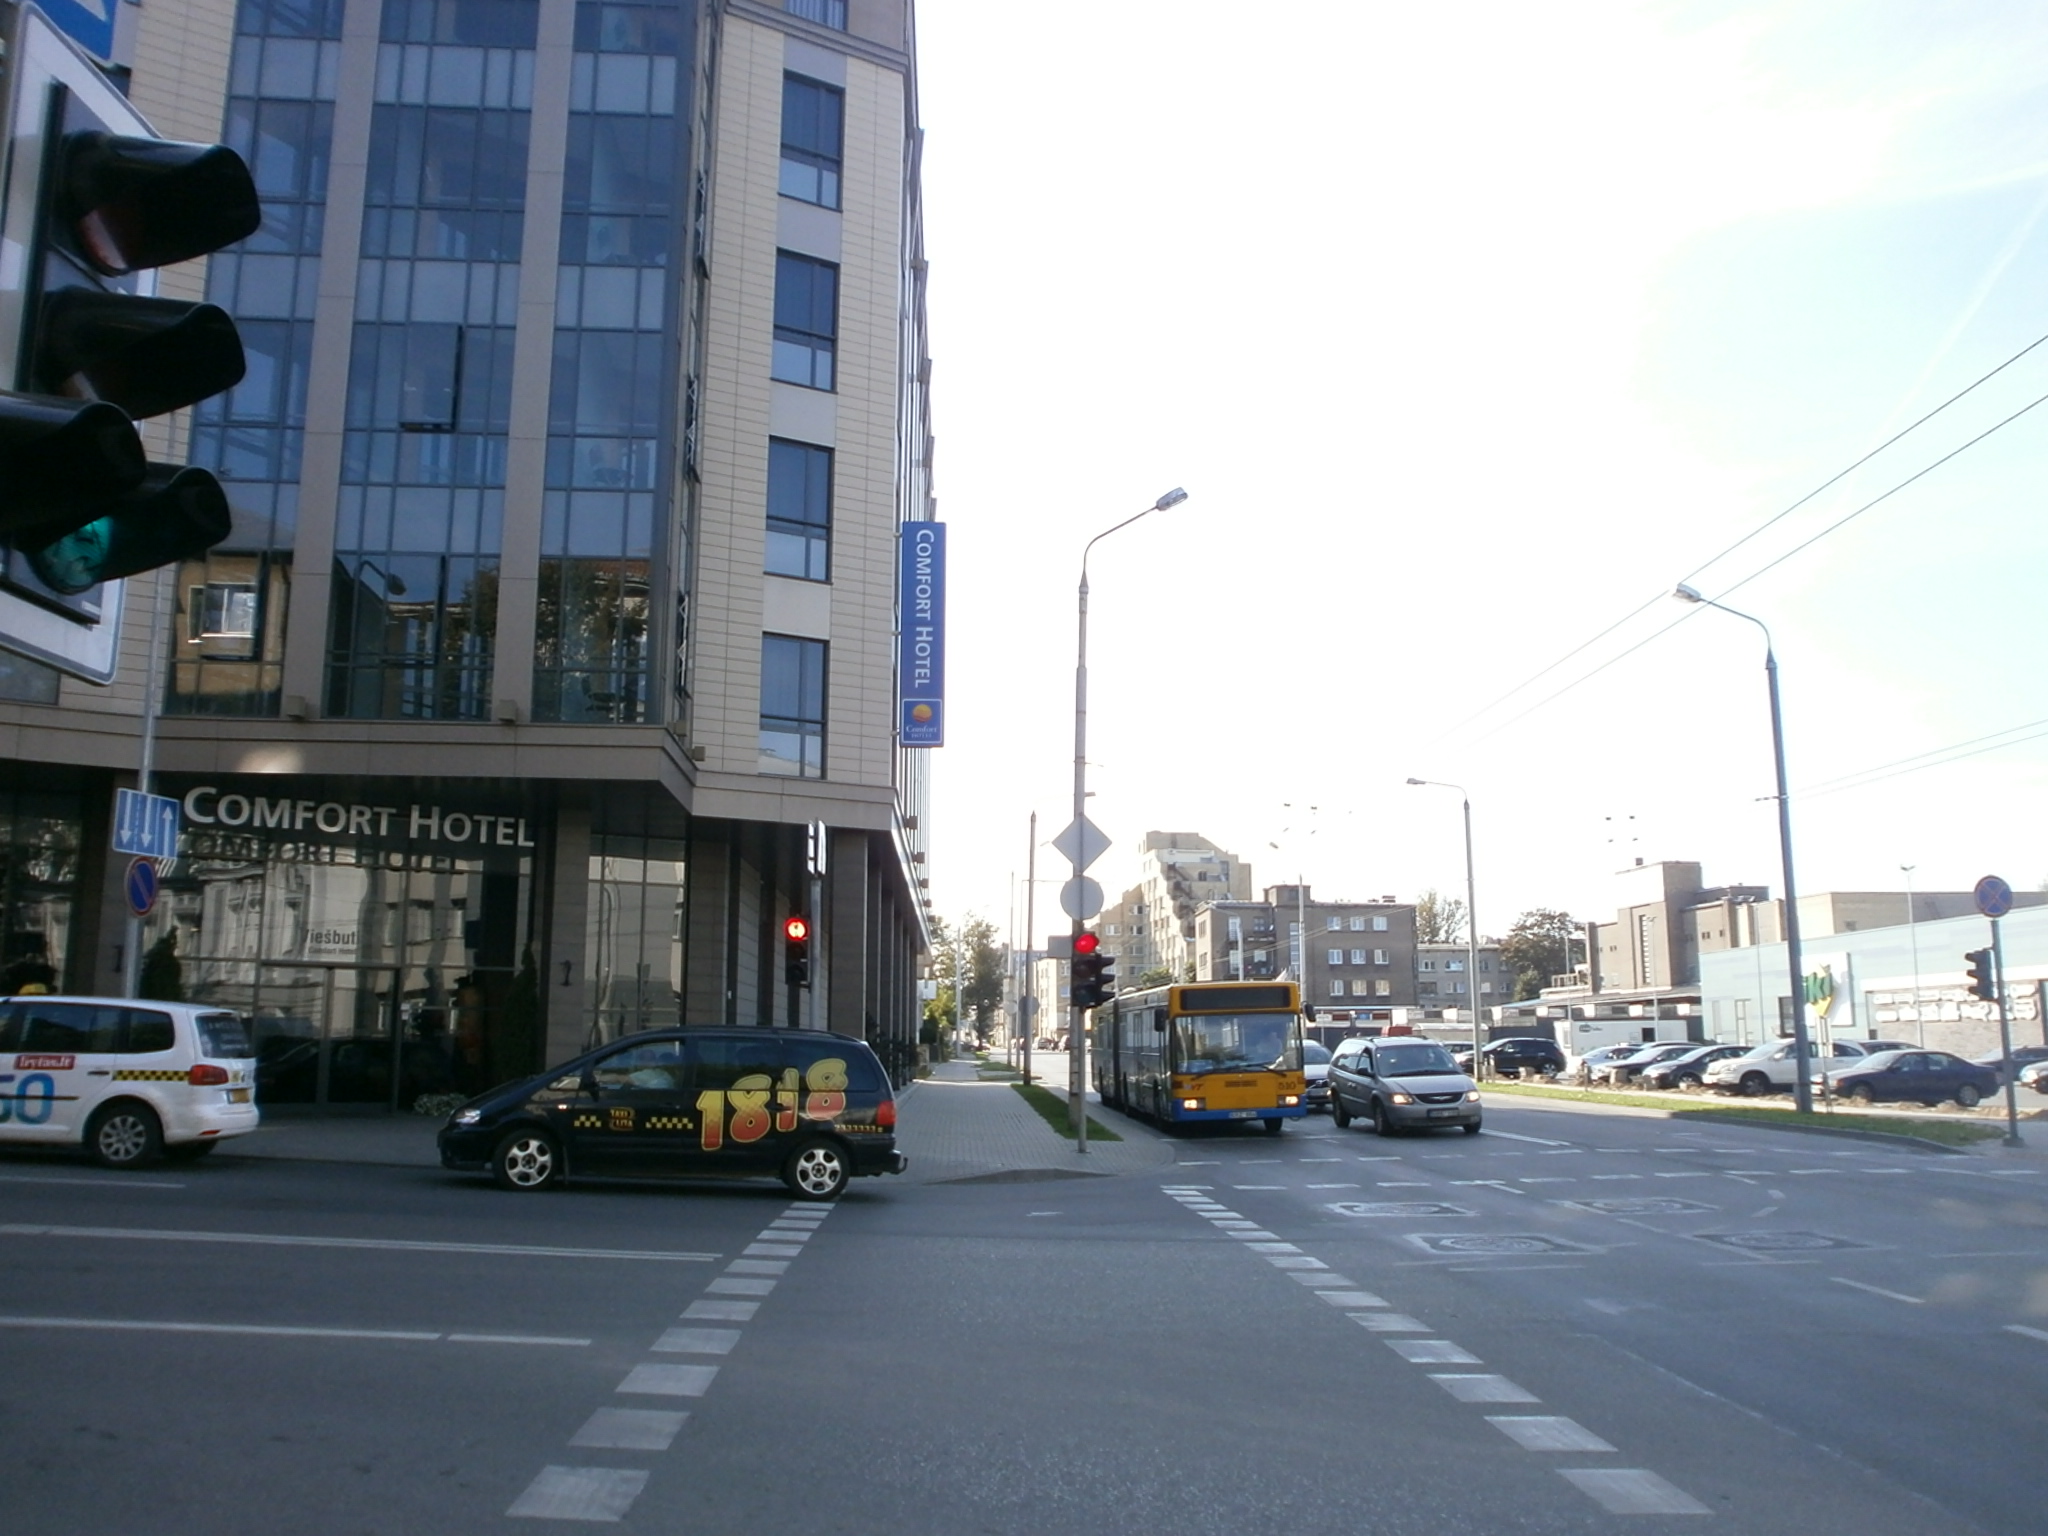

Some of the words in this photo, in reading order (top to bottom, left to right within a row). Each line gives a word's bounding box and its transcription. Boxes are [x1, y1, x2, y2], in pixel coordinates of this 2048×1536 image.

[916, 529, 934, 621] COMFORT
[915, 627, 934, 688] HOTEL
[184, 787, 396, 836] COMFORT
[409, 804, 535, 848] HOTEL
[696, 1058, 848, 1151] 1818
